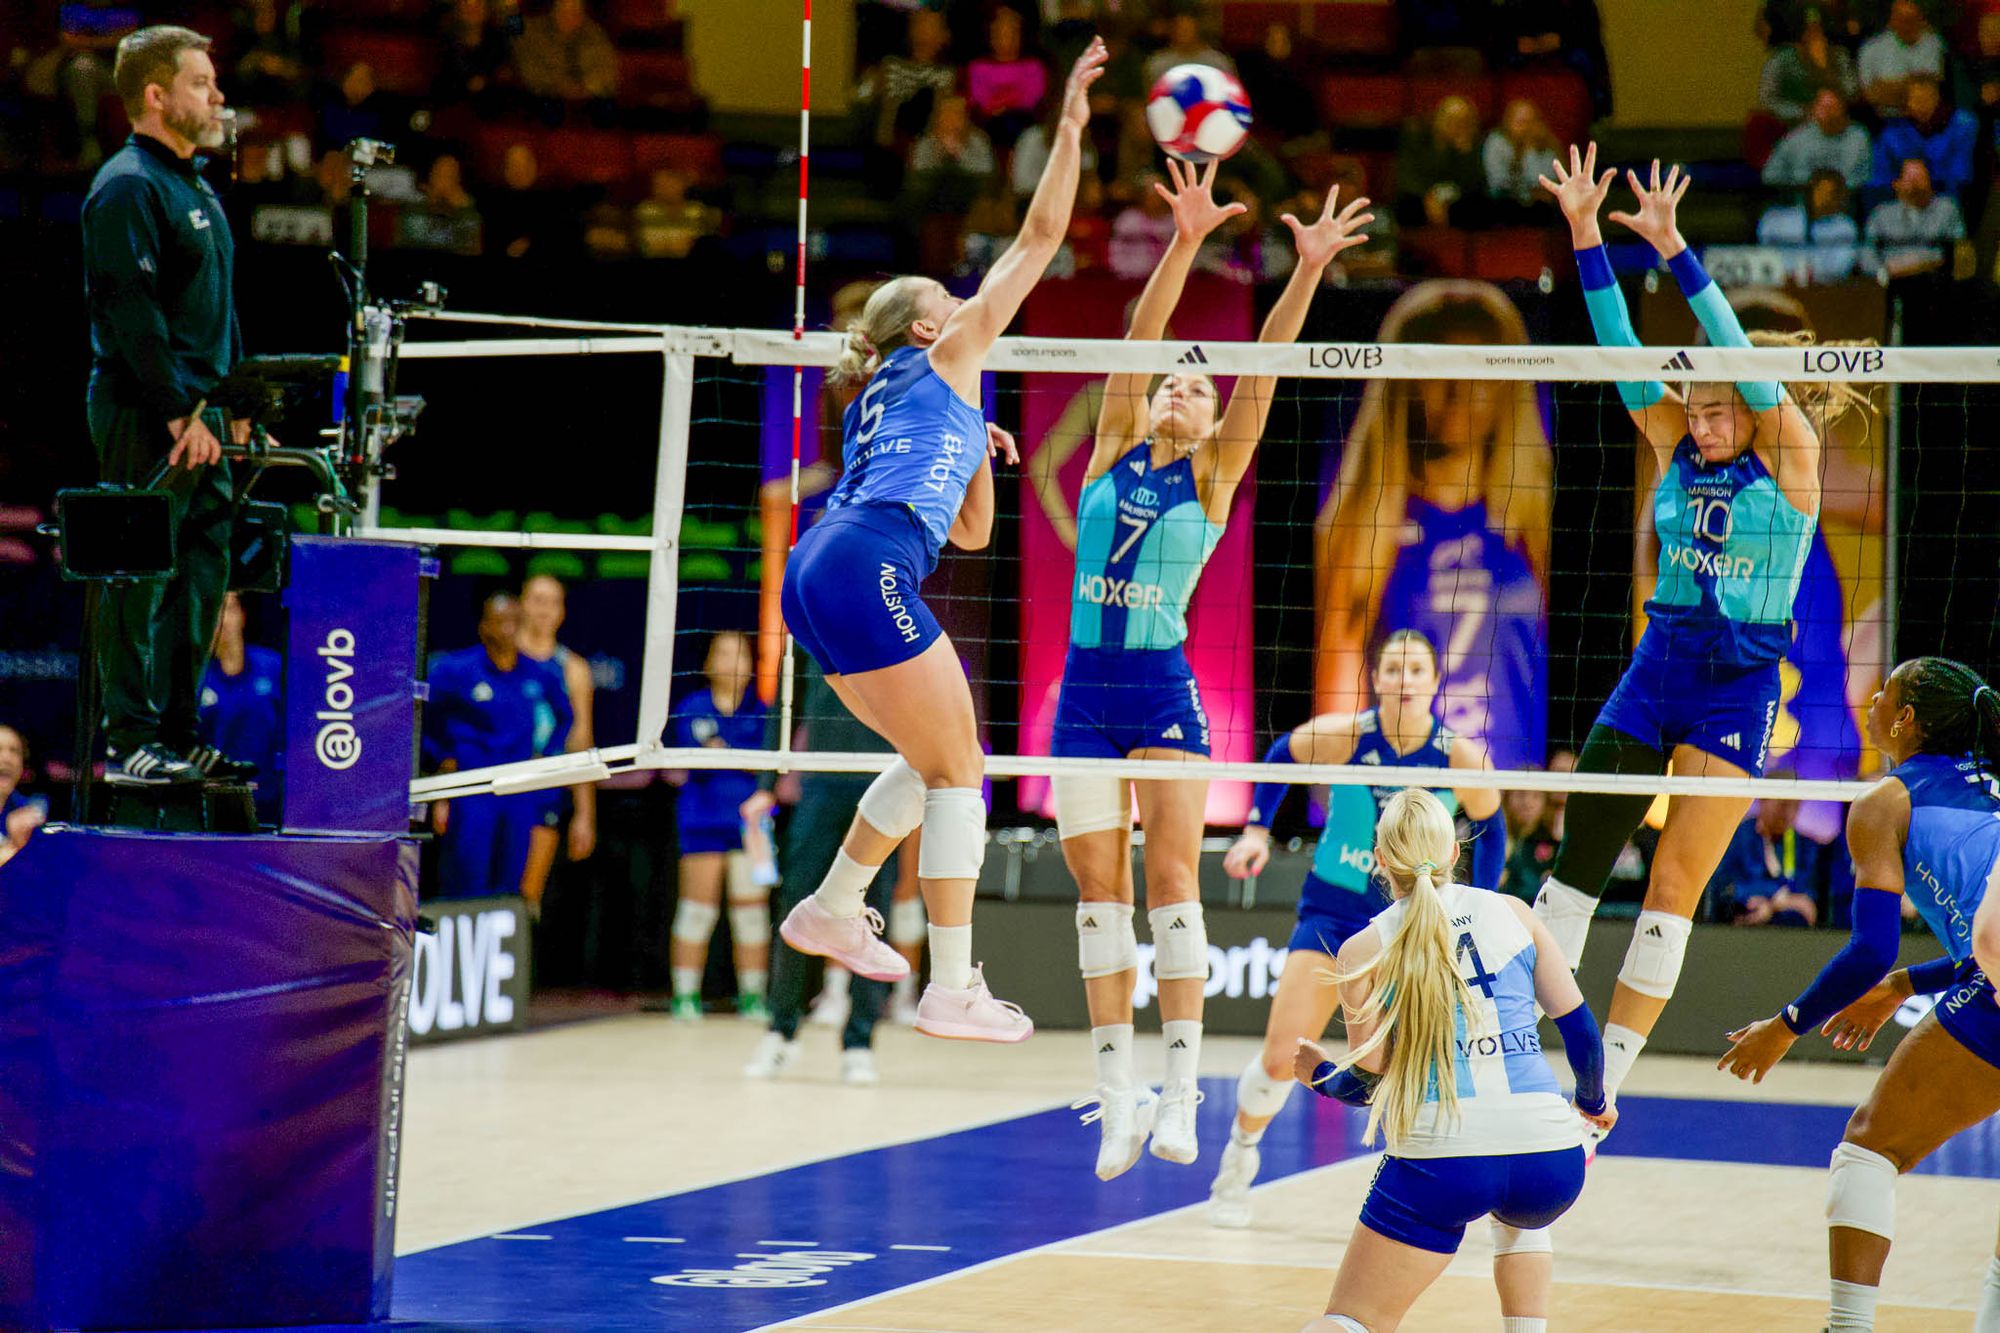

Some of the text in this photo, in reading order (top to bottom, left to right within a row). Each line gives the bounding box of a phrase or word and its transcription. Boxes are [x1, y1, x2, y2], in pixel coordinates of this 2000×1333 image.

[1485, 356, 1515, 366] sports
[856, 378, 888, 444] 5
[1110, 513, 1148, 564] 7
[1687, 497, 1733, 543] 10
[880, 562, 920, 643] HOUSTON
[315, 628, 362, 770] @lovb
[1914, 861, 1970, 943] HOUSTO
[1456, 932, 1497, 999] 4
